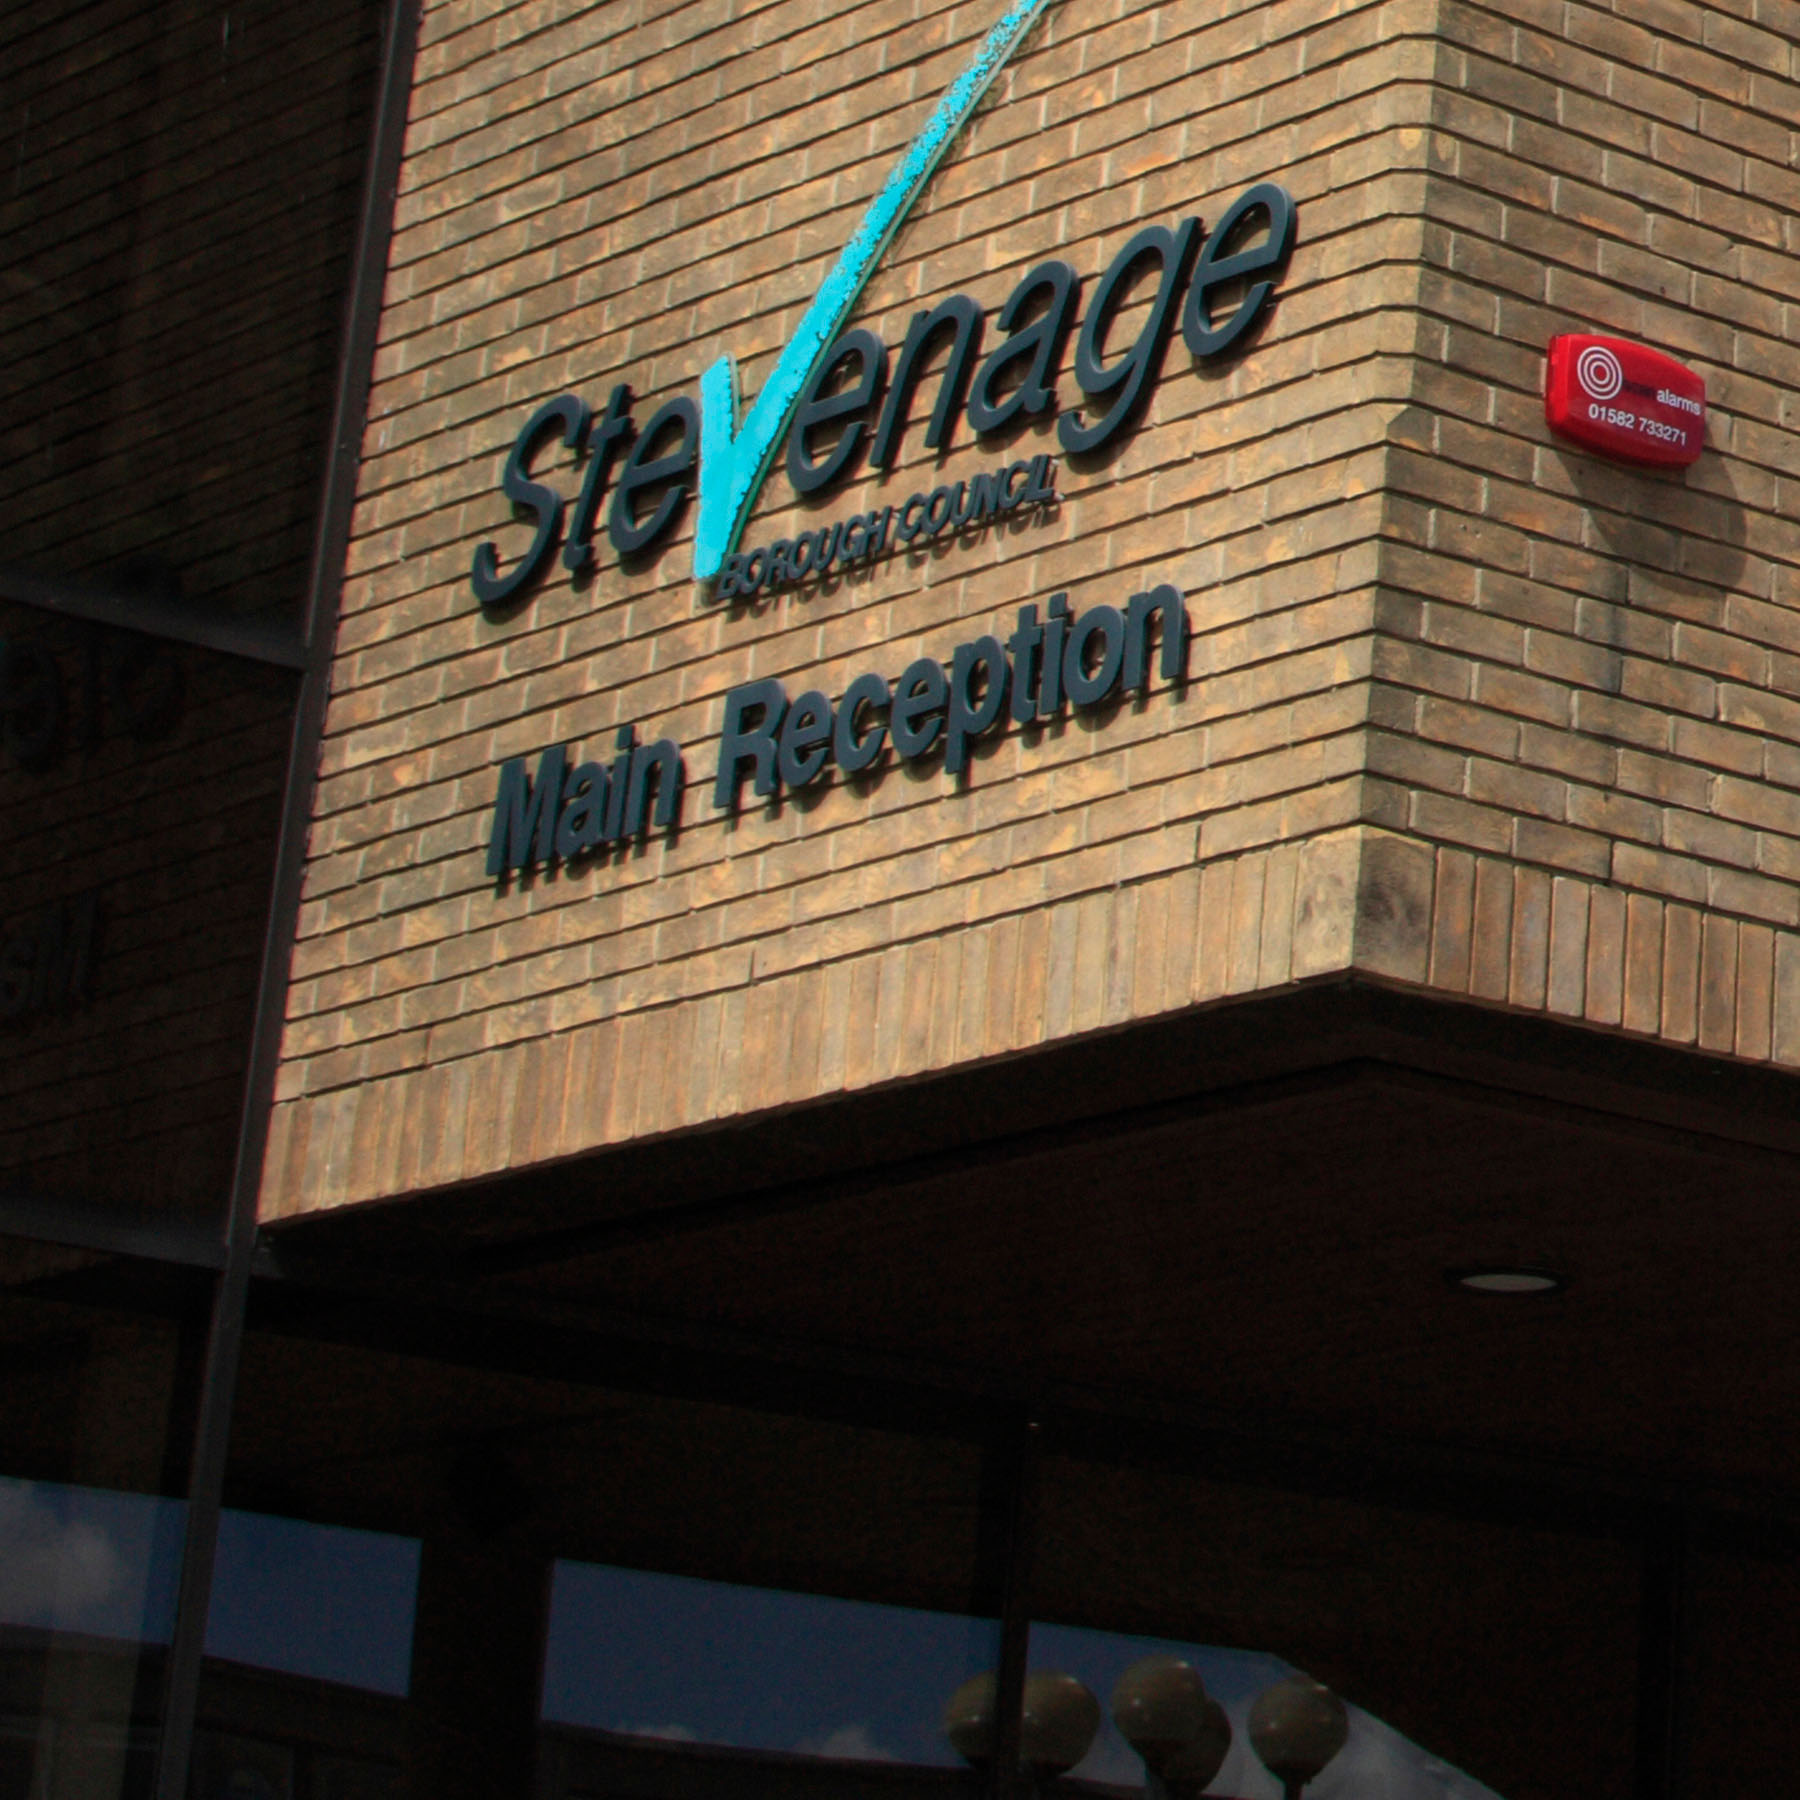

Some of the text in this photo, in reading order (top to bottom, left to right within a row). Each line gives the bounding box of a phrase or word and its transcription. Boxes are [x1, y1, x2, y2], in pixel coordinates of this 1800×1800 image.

[1588, 403, 1686, 446] 01582 733271
[1656, 388, 1701, 416] alarms
[715, 454, 1056, 599] BOROUGH COUNCIL
[484, 584, 1187, 878] Main Reception
